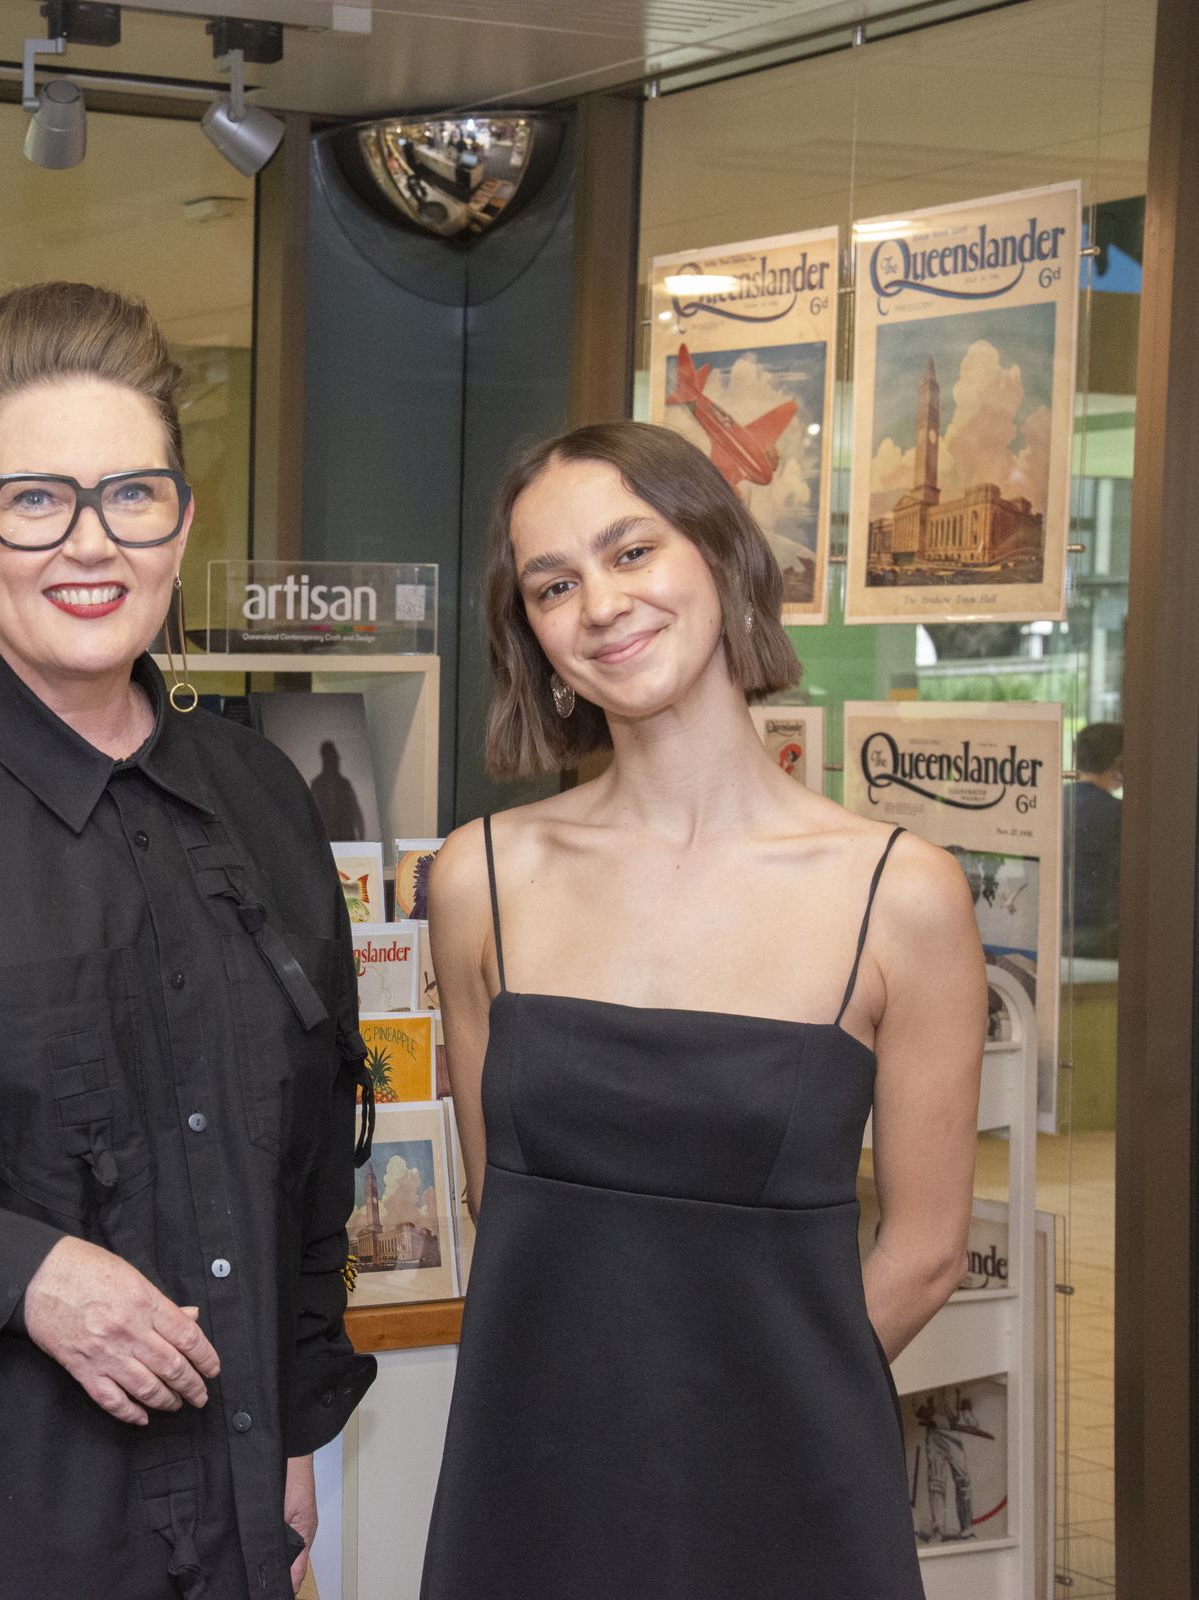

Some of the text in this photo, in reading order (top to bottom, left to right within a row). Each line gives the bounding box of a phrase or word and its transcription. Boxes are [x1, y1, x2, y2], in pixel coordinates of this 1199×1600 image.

[869, 217, 1066, 312] Queenslander
[1038, 266, 1062, 289] 6d
[242, 574, 377, 621] artisan
[242, 632, 280, 641] Queensland
[280, 632, 325, 643] Contemporary
[325, 633, 342, 641] Craft
[860, 732, 1043, 810] Queenslander
[1015, 794, 1037, 814] 6d
[373, 1025, 419, 1059] PINEAPPLE
